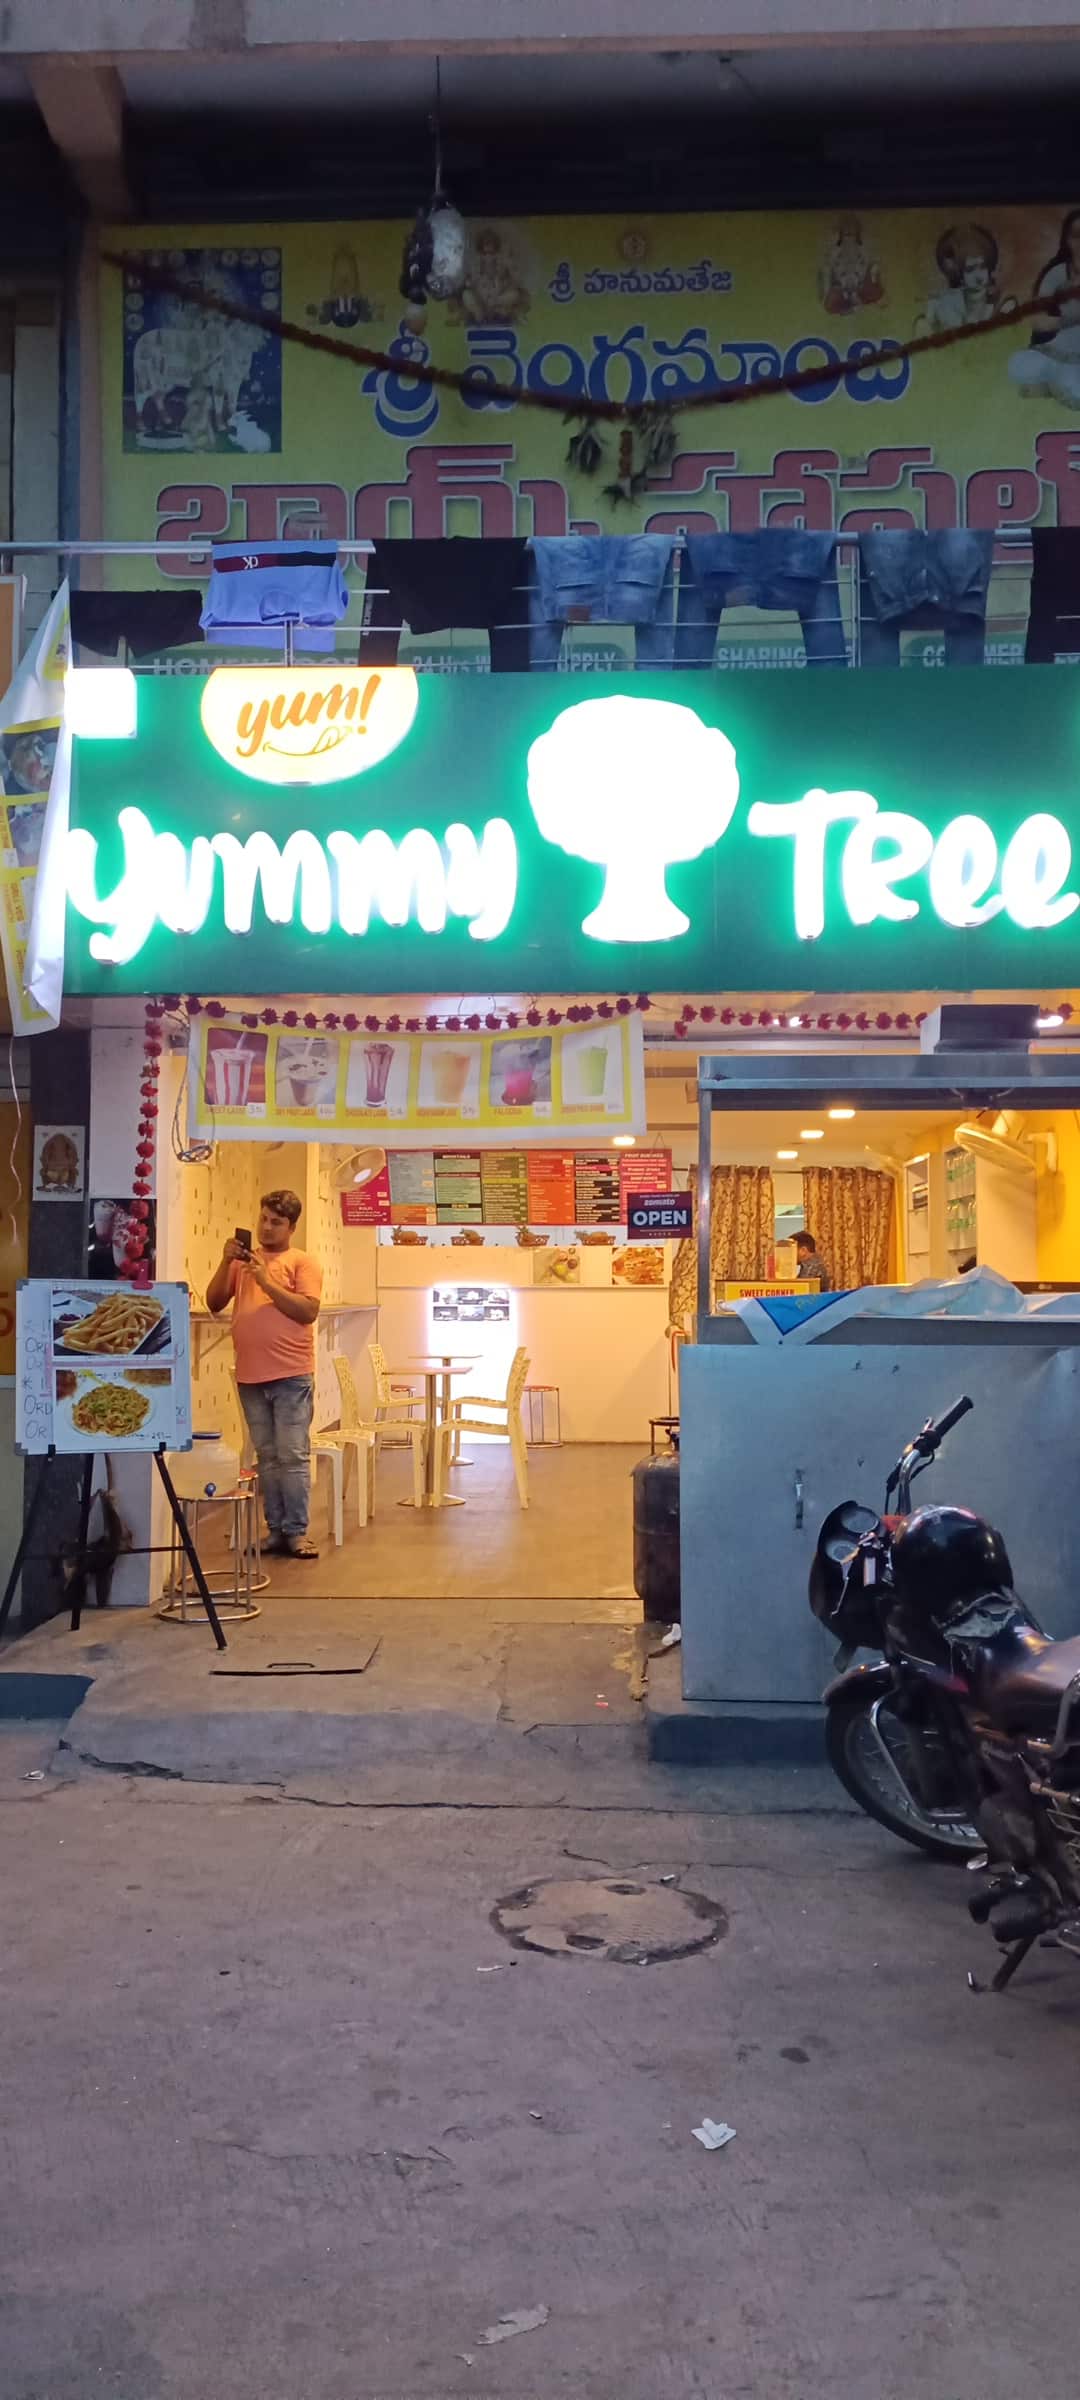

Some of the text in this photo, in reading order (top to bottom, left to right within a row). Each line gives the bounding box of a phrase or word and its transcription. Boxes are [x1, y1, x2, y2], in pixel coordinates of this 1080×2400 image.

[548, 261, 575, 302] శ్రీ
[361, 316, 440, 438] శ్రీ
[556, 652, 616, 672] UPPLY
[717, 646, 808, 671] SHARING
[632, 1210, 687, 1226] OPEN
[740, 1288, 761, 1297] SWEET
